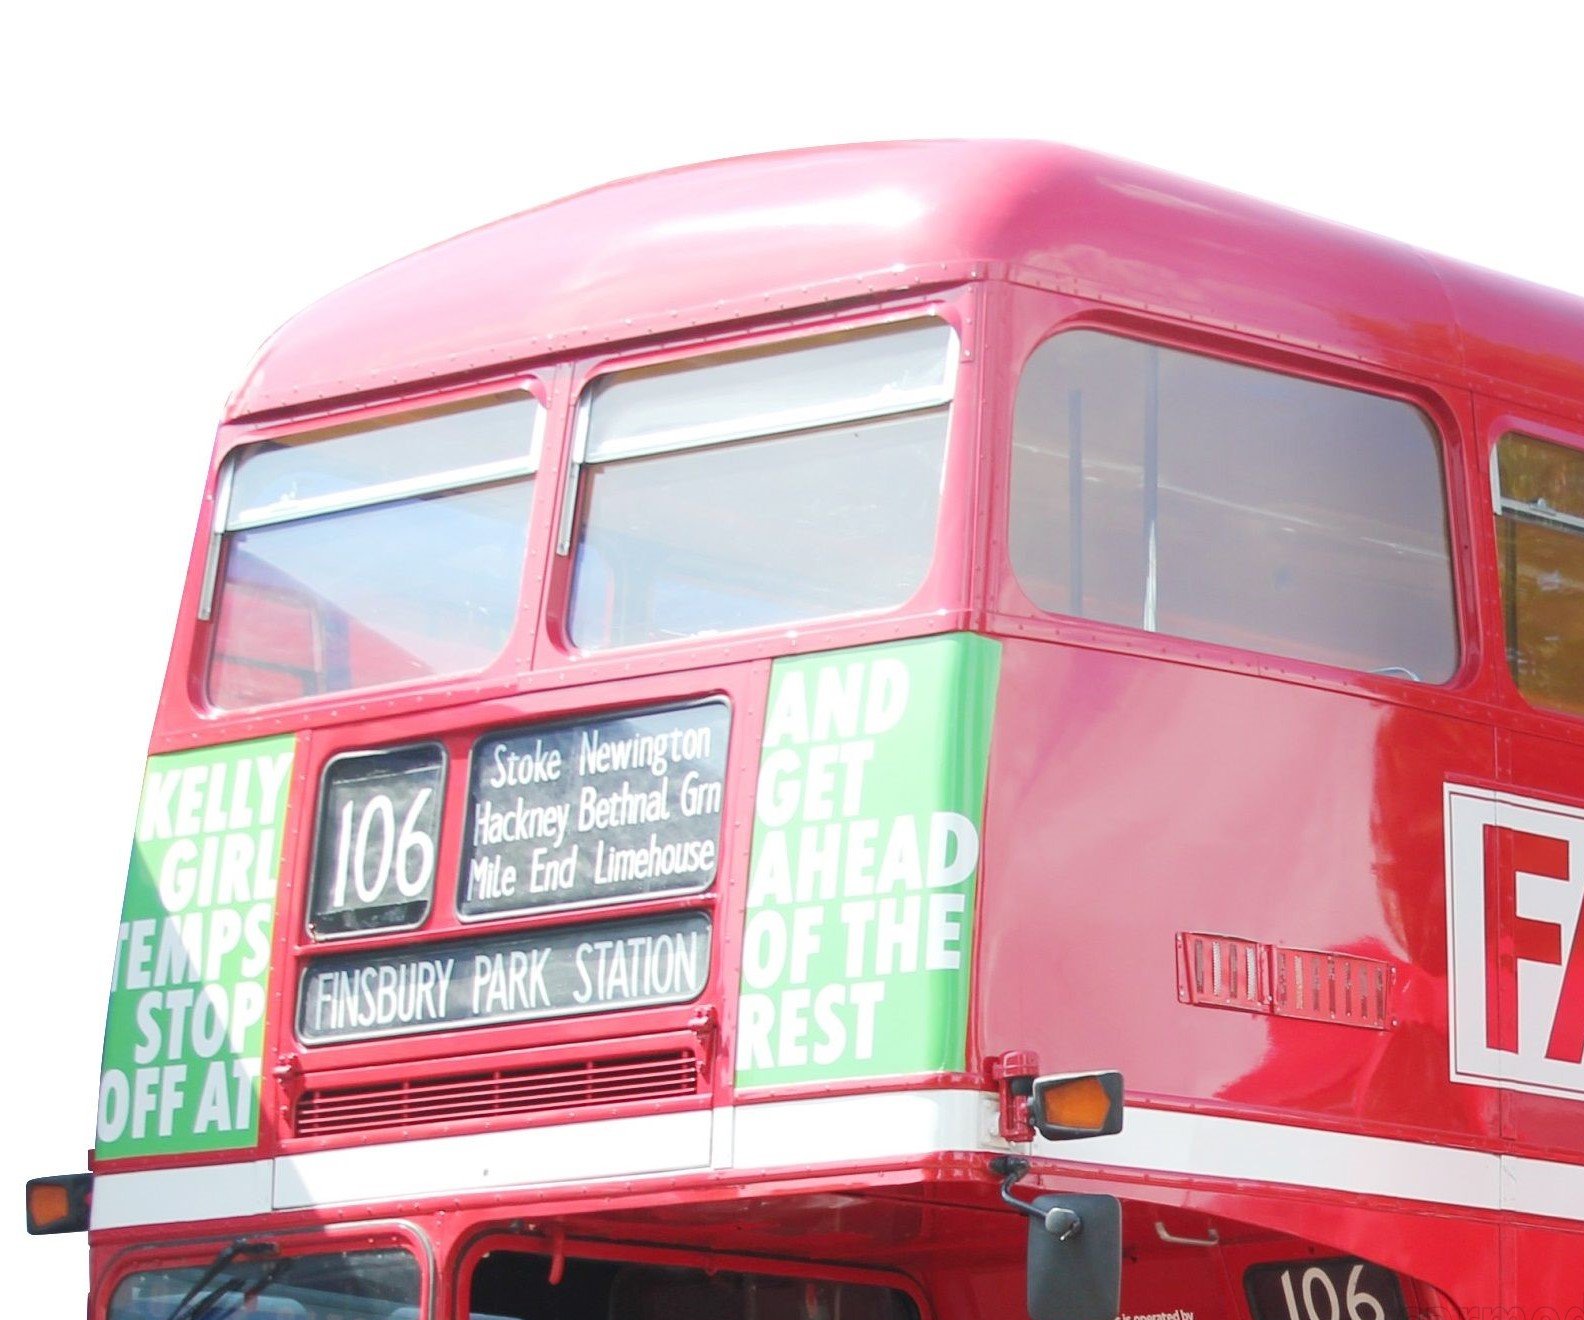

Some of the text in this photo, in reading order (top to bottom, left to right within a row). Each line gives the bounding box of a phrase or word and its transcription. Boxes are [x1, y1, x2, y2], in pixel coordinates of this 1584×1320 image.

[762, 658, 910, 748] AND
[139, 753, 294, 842] KELLY
[491, 726, 711, 788] Stoke Newington
[756, 740, 875, 827] GET
[333, 788, 434, 907] 106
[474, 771, 722, 849] Hackney Bethnal Grn
[160, 829, 278, 912] GIRL
[467, 834, 715, 900] Mile End Limehouse
[747, 812, 980, 908] AHEAD
[315, 932, 698, 1031] FINSBURY PARK STATION
[743, 894, 966, 989] OF THE
[134, 982, 265, 1064] STOP
[736, 981, 885, 1071] REST
[98, 1058, 261, 1142] OFF AT
